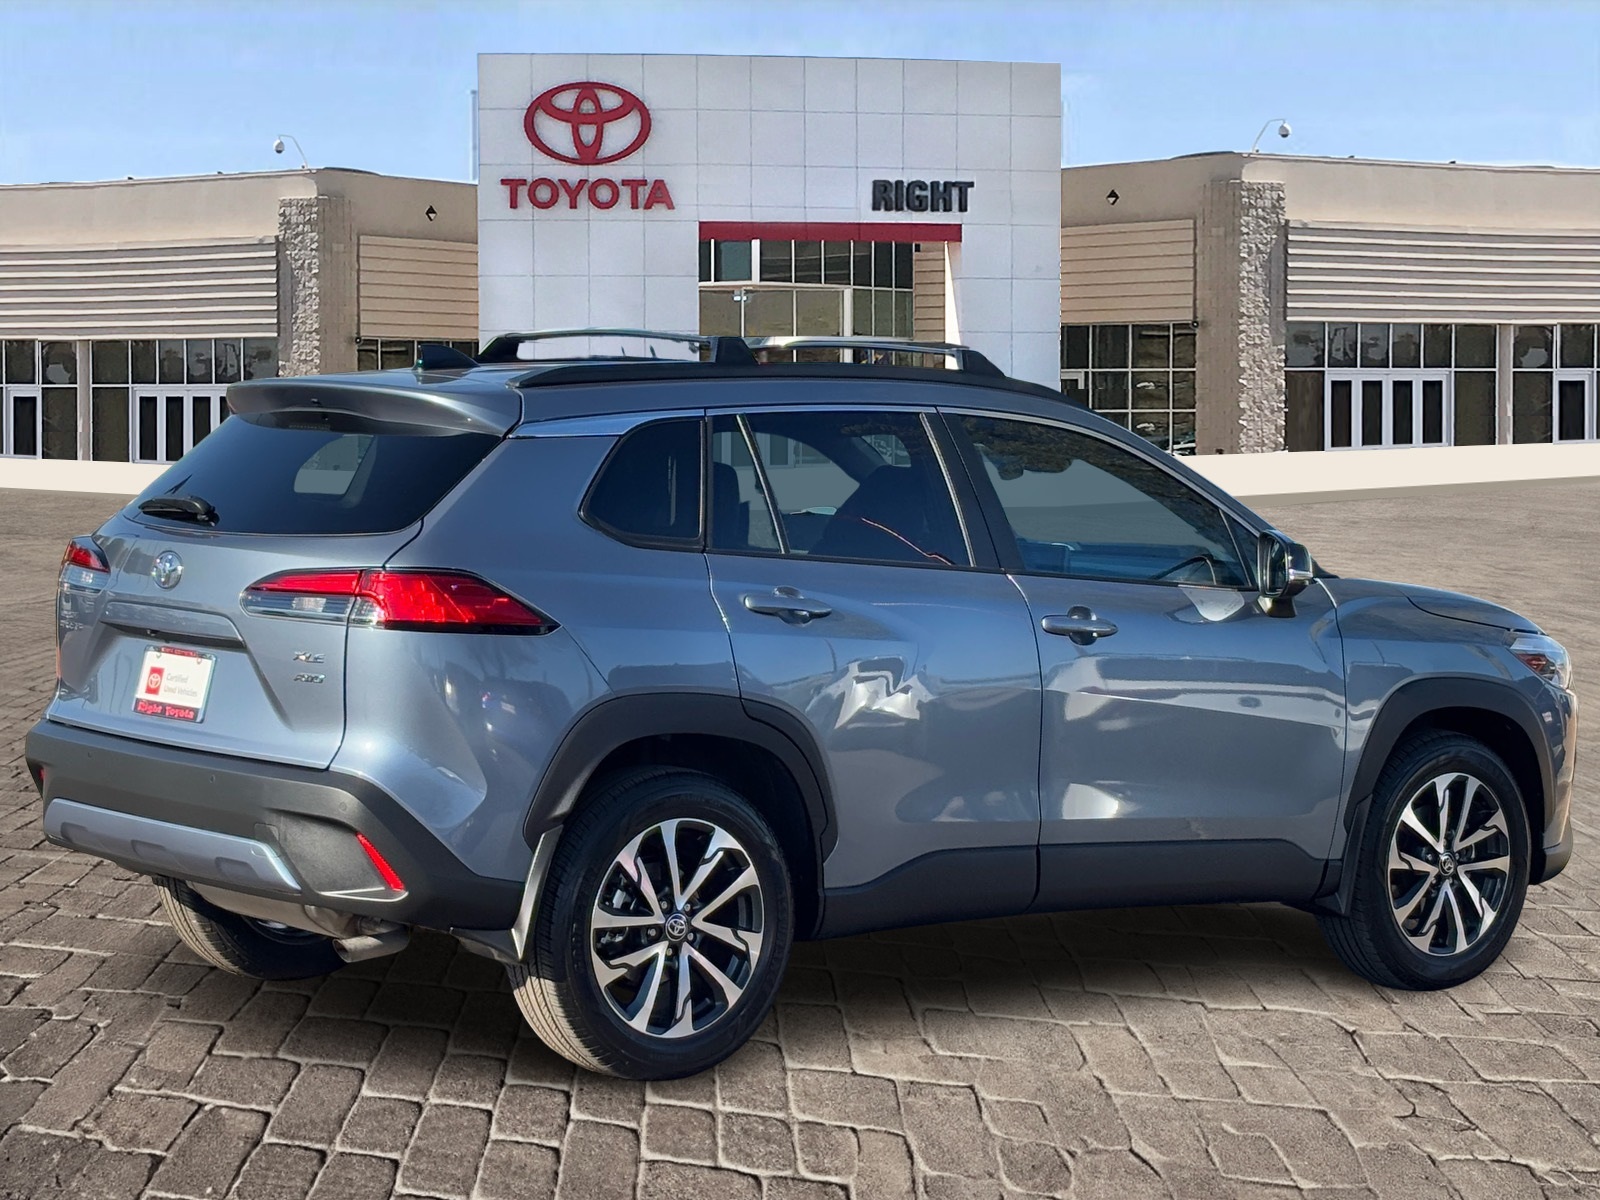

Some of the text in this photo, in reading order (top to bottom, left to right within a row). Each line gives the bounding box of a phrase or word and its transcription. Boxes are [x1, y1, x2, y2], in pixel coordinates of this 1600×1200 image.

[501, 178, 675, 210] TOYOTA
[871, 179, 974, 213] RIGHT
[137, 700, 194, 719] Right Toyota
